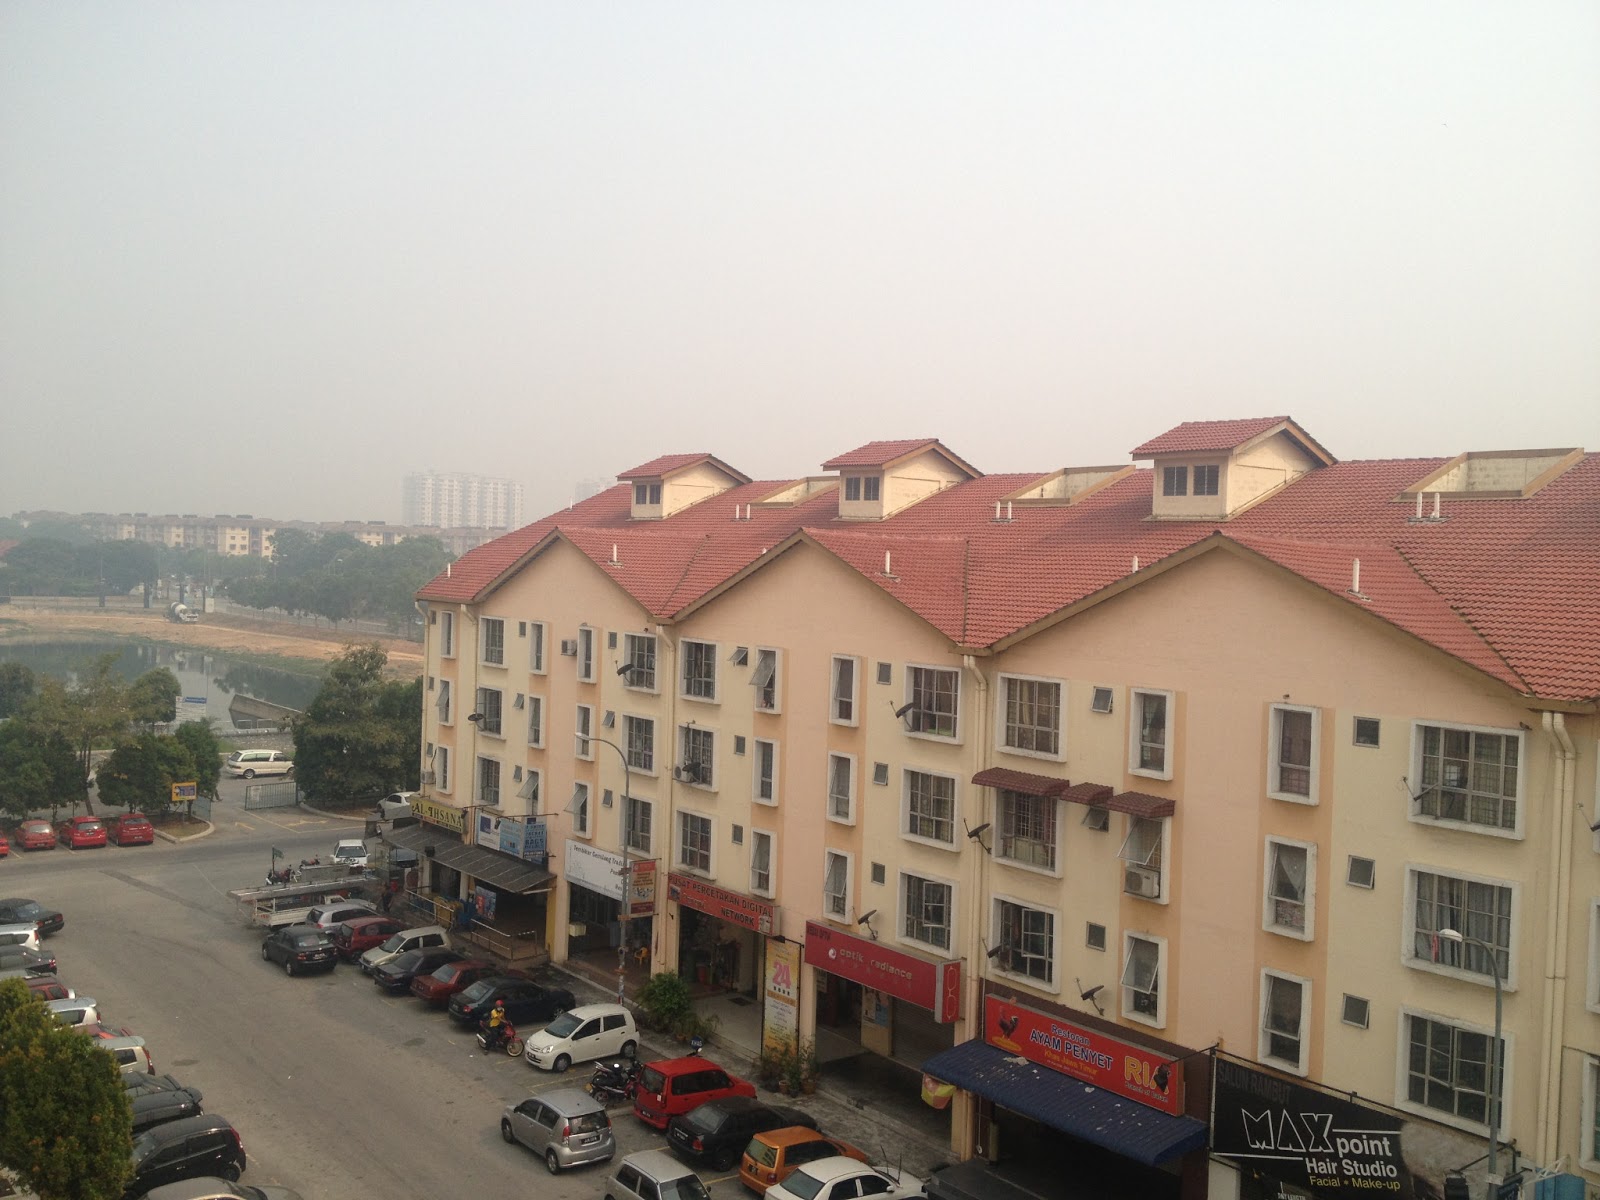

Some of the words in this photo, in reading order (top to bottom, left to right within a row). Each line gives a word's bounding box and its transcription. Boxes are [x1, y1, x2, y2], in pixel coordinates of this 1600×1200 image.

[669, 875, 690, 888] PUSAT
[693, 885, 739, 906] PERCETAKAN
[742, 900, 773, 918] DIGITAL
[721, 908, 755, 926] NETWORK
[772, 960, 791, 989] 24
[870, 960, 912, 980] radiance
[1051, 1024, 1091, 1046] Restoran
[1030, 1030, 1061, 1052] AYAM
[1064, 1040, 1114, 1070] PENYET
[1250, 1074, 1291, 1104] RAMBUT
[1241, 1107, 1334, 1153] MAX
[1336, 1134, 1392, 1158] point
[1306, 1157, 1337, 1175] Hair
[1343, 1159, 1397, 1178] Studio
[1309, 1175, 1341, 1188] Facial
[1352, 1176, 1401, 1191] Make-up
